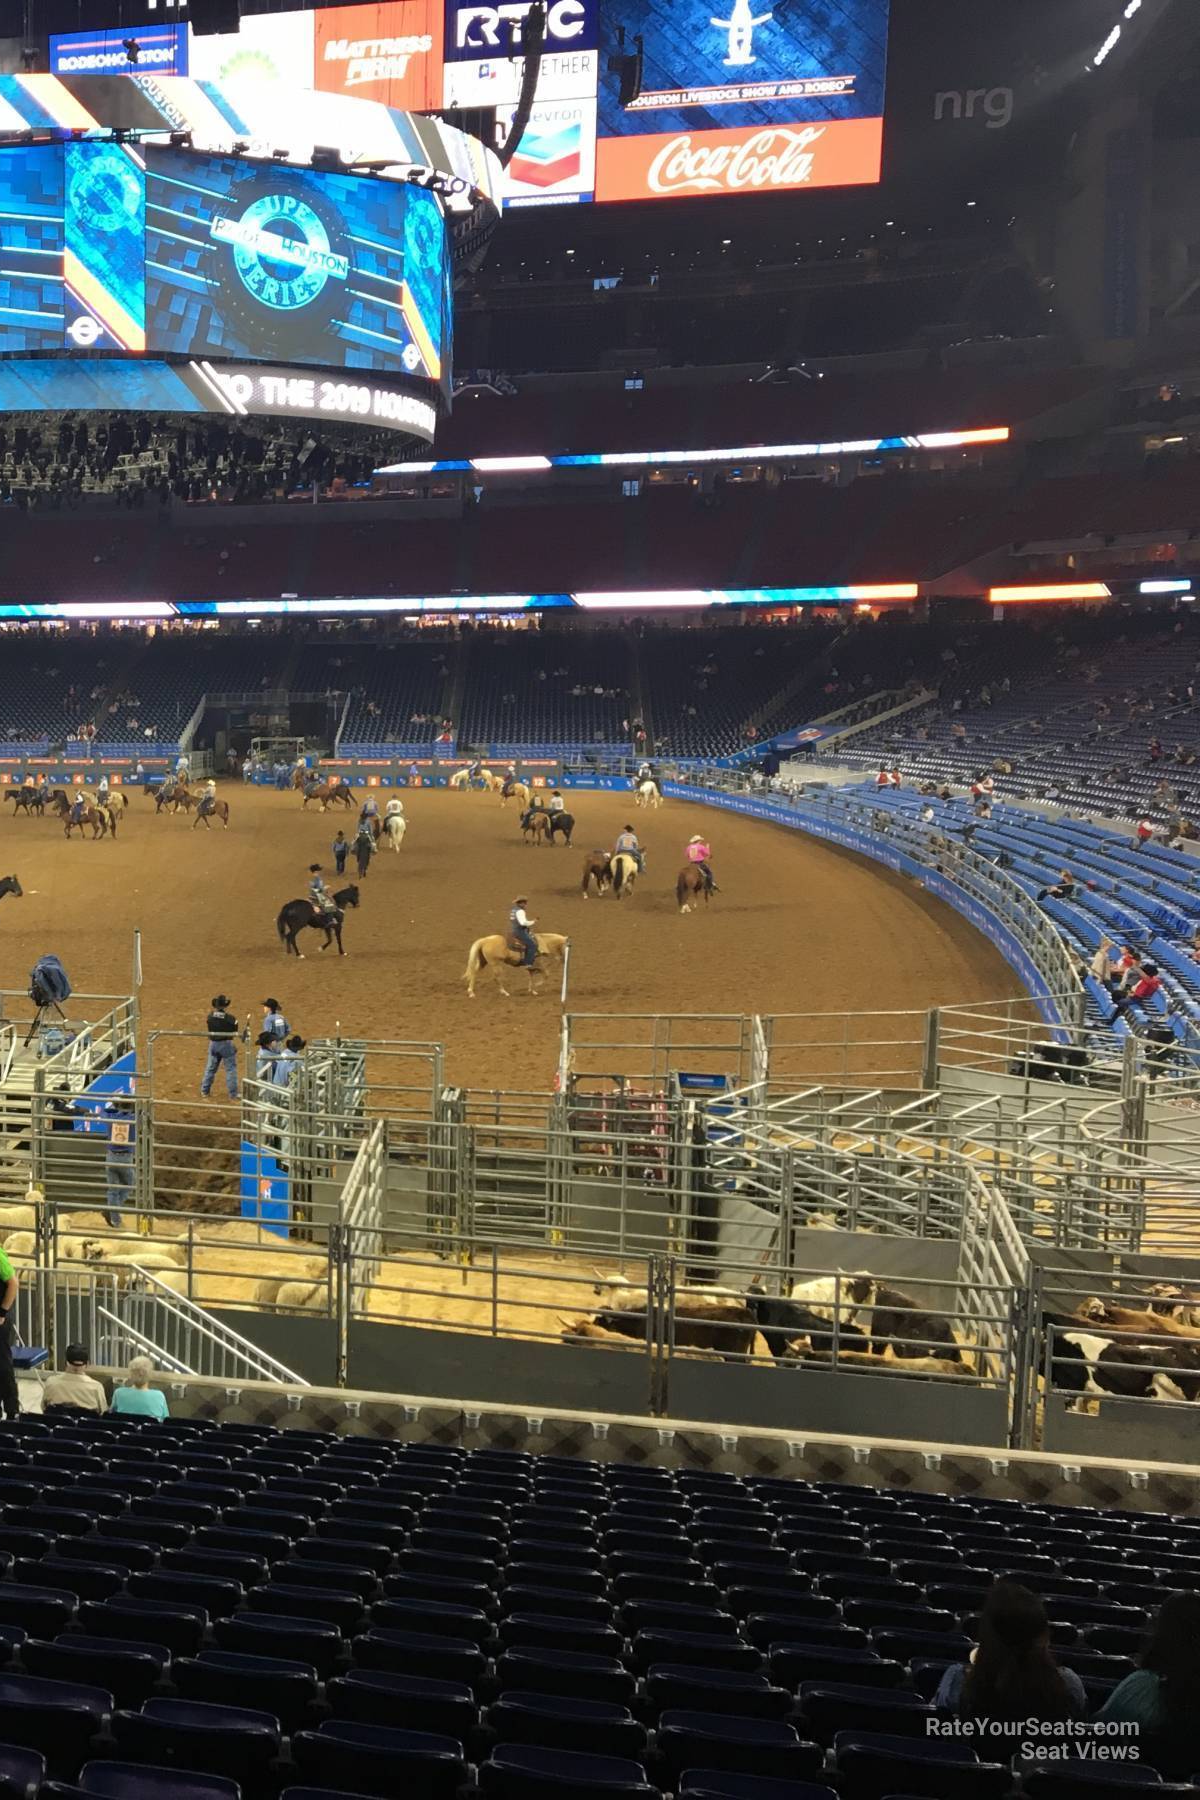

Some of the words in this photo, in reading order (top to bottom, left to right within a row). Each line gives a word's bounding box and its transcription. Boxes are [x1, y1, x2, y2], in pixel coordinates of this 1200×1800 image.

[58, 49, 175, 70] RODEOHOSTON
[324, 35, 432, 61] MATTRESS
[344, 54, 412, 86] FIRM
[513, 56, 591, 80] TETHER
[137, 75, 185, 124] OUSTON
[682, 88, 740, 103] LIVESTOCK
[742, 85, 778, 98] SHOW
[779, 84, 803, 96] AND
[934, 87, 1013, 128] nrg
[511, 108, 583, 124] evron
[647, 127, 826, 193] Coca-Cola
[255, 195, 320, 235] SUPE
[259, 376, 315, 408] THE
[319, 382, 371, 414] 2019
